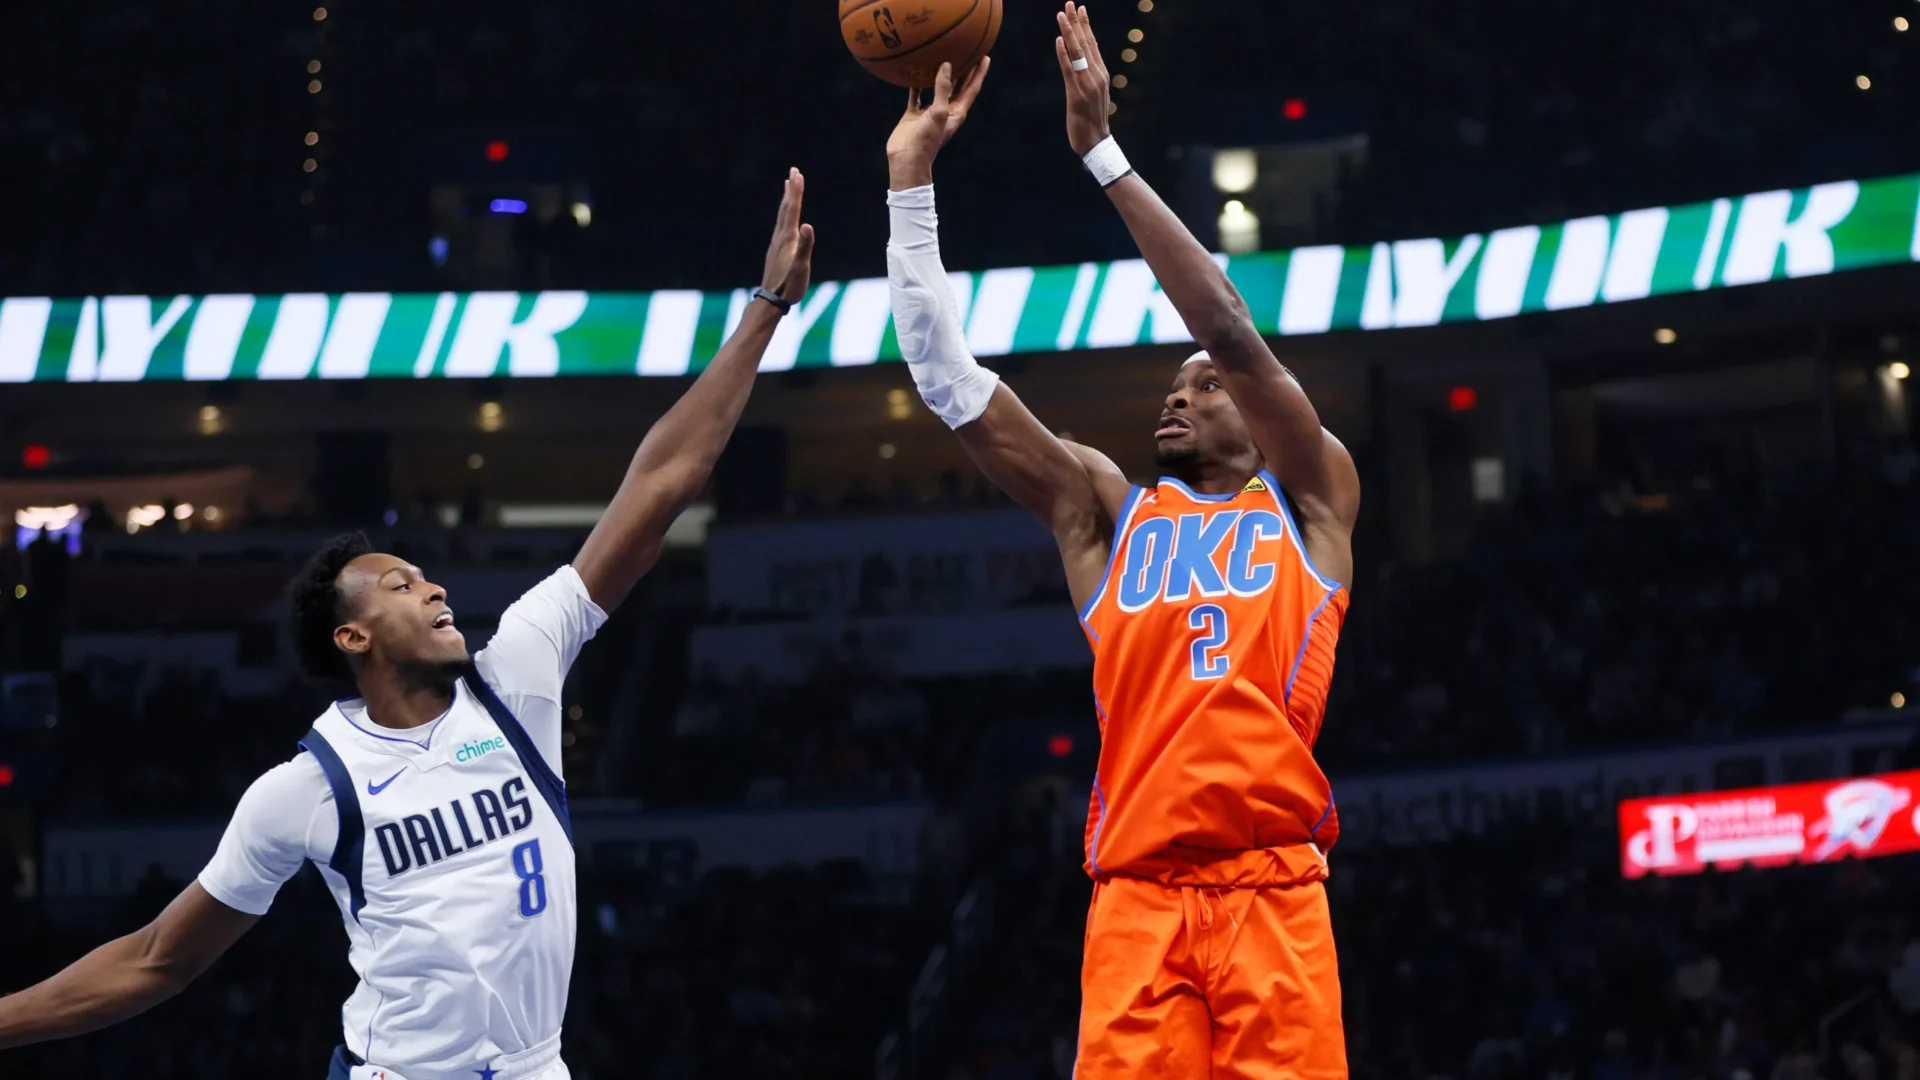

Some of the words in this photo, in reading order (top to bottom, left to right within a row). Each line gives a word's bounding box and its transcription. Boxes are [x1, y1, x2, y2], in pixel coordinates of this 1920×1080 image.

[1117, 510, 1283, 613] OKC
[1189, 603, 1230, 680] 2
[456, 735, 505, 762] chime
[374, 776, 533, 879] DALLAS
[512, 838, 547, 919] 8
